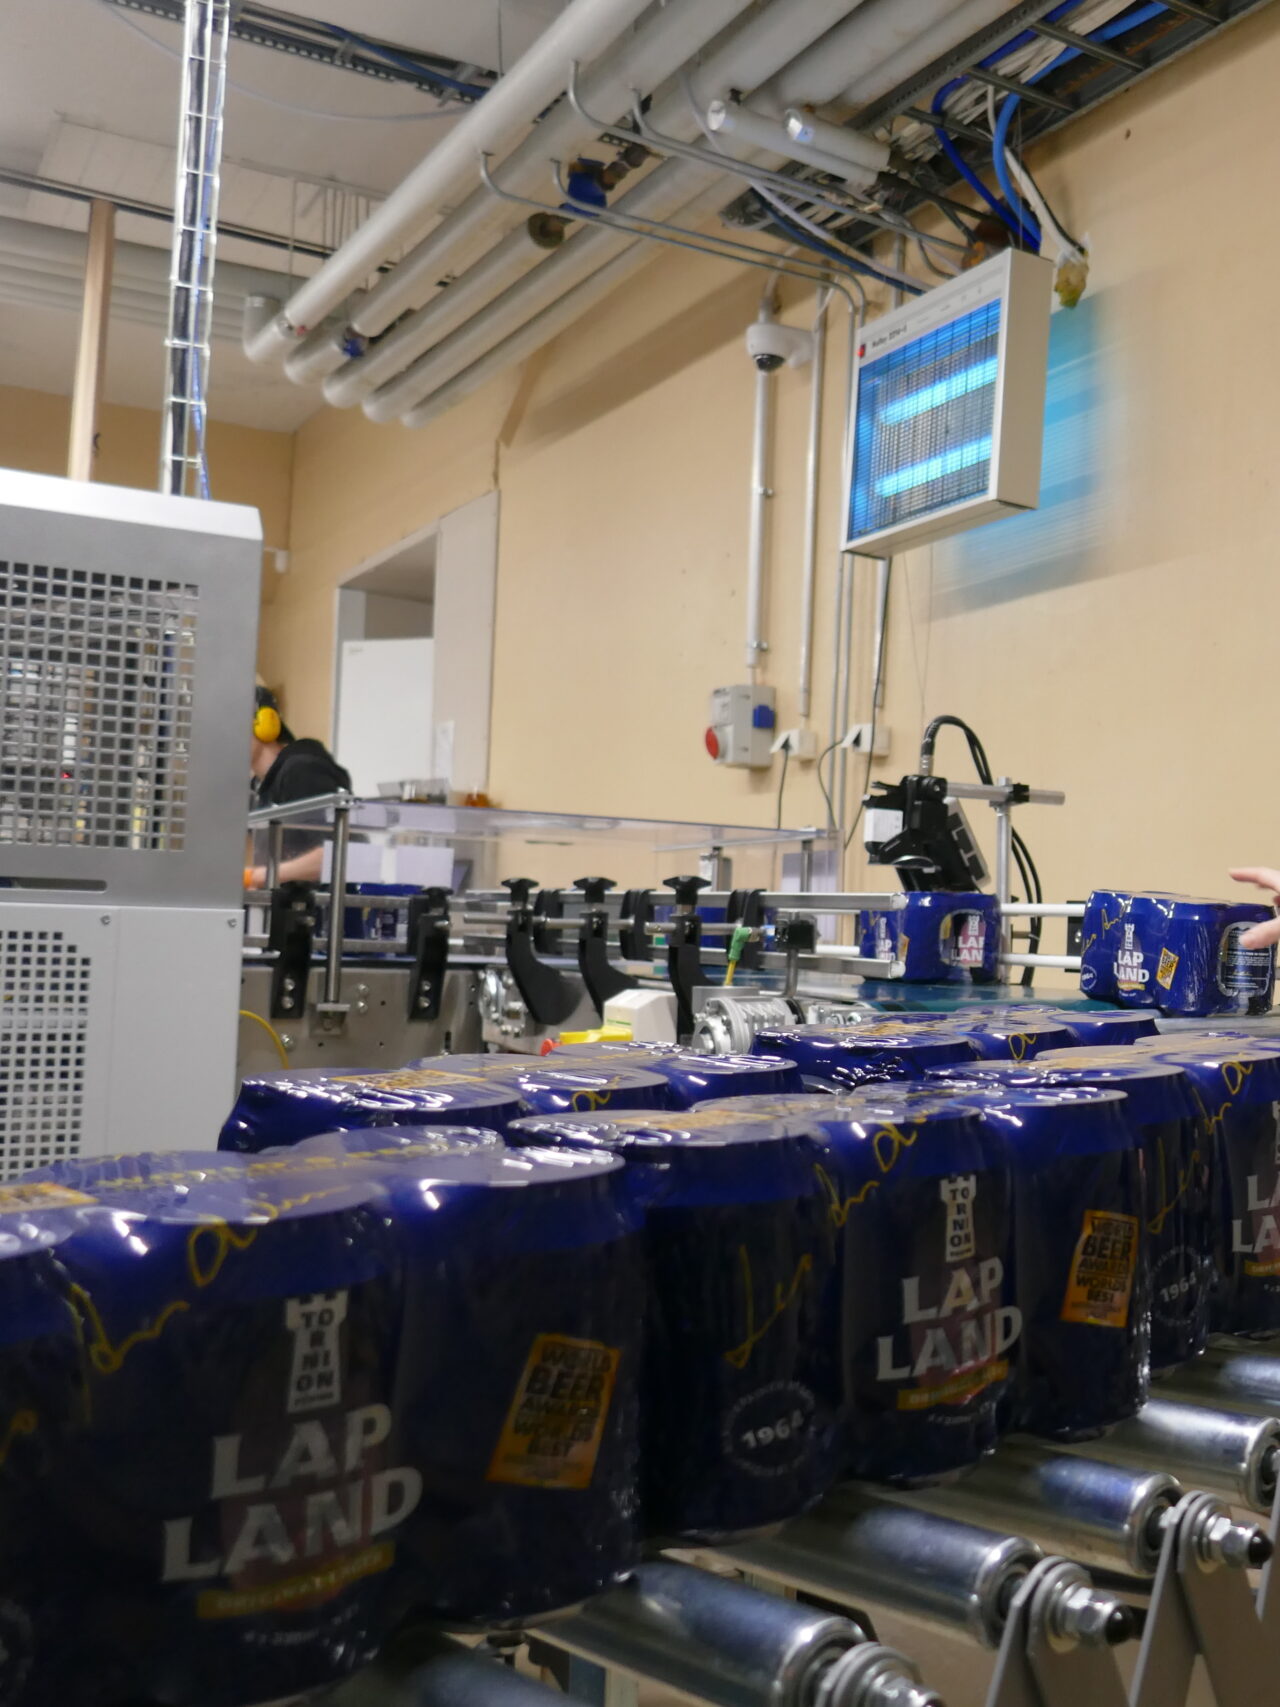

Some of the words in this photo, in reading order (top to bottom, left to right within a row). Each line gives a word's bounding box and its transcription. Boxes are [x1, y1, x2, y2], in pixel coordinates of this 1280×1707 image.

[1118, 950, 1144, 966] LAP
[1113, 962, 1150, 982] LAND
[950, 1187, 969, 1200] TO
[957, 1203, 966, 1215] R
[953, 1217, 969, 1231] NI
[950, 1232, 971, 1247] ON
[1083, 1234, 1132, 1260] BEER
[901, 1256, 1004, 1325] LAP
[1160, 1271, 1197, 1302] 1964
[301, 1308, 333, 1328] TO
[876, 1304, 1023, 1381] LAND
[303, 1351, 330, 1370] NI
[297, 1371, 334, 1391] ON
[526, 1367, 605, 1400] BEER
[741, 1408, 805, 1449] 1964
[210, 1403, 392, 1500] LAP
[160, 1466, 424, 1584] LAND
